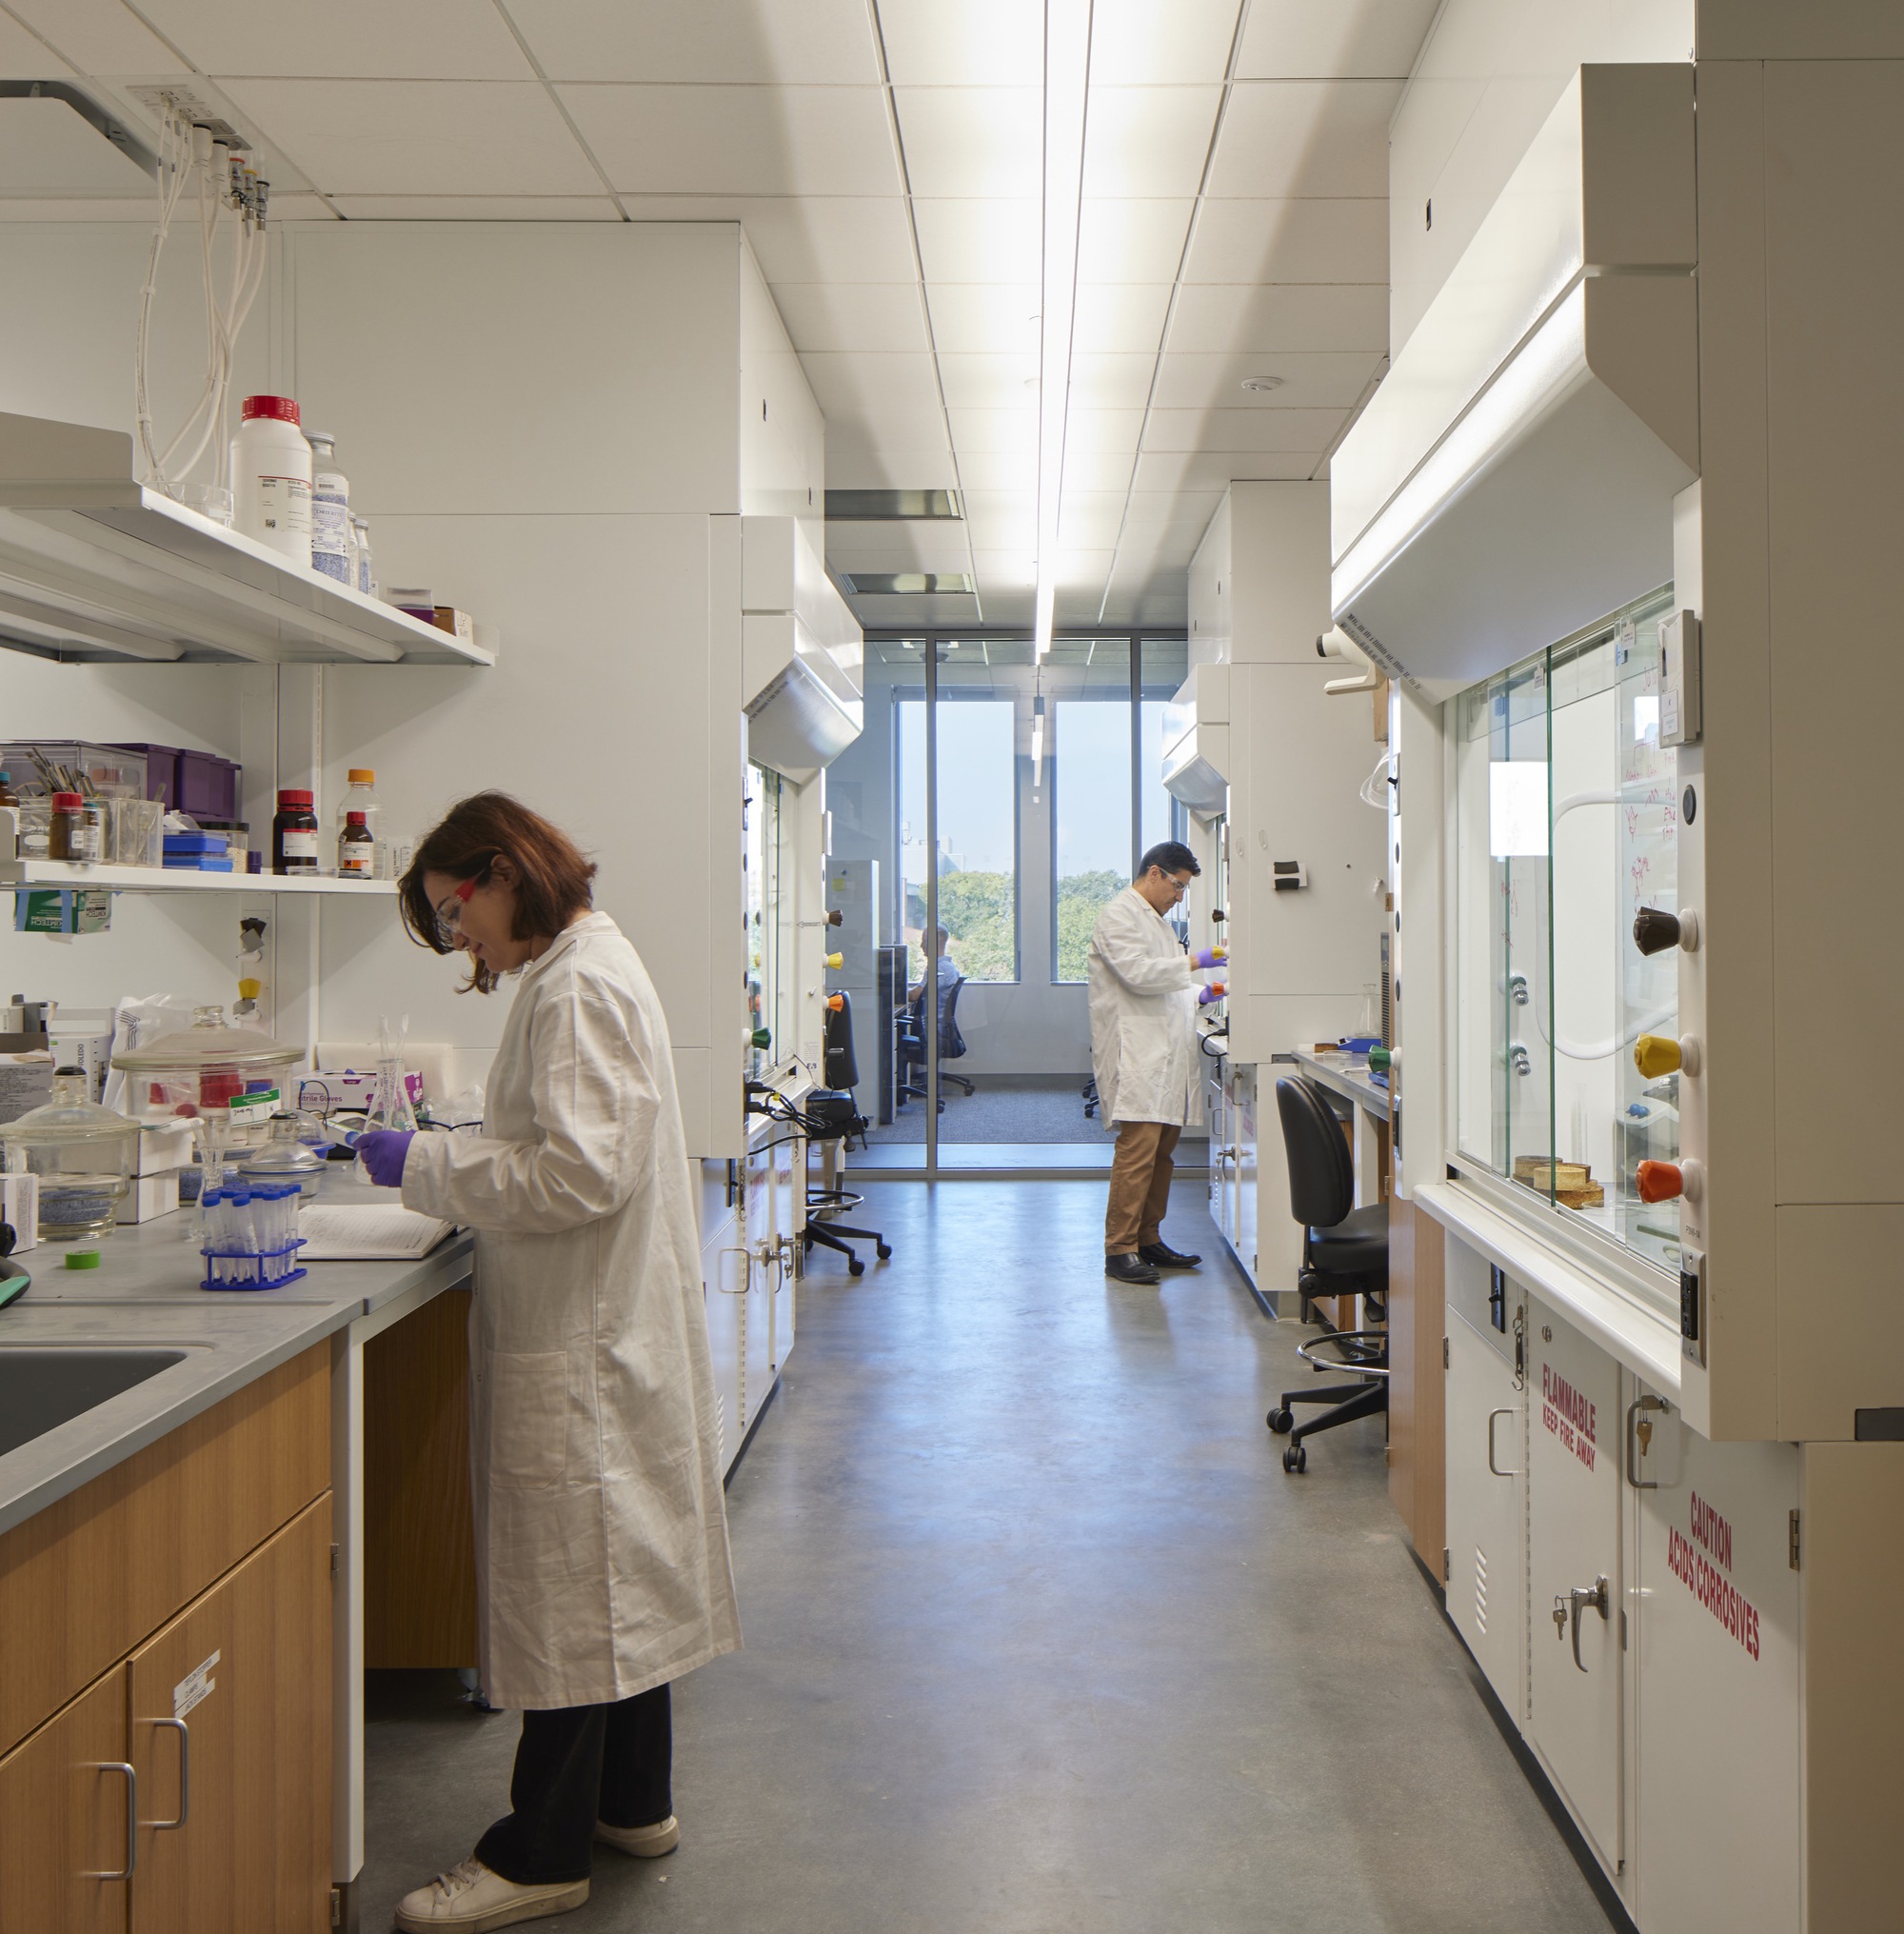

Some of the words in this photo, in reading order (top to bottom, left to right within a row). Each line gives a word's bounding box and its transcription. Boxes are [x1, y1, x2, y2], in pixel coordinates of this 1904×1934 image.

[1543, 1363, 1596, 1445] FLAMMABLE
[1543, 1403, 1557, 1435] KEEP
[1560, 1419, 1574, 1453] FIRE
[1577, 1436, 1596, 1472] AWAY
[1691, 1490, 1732, 1572] CAUTION
[1668, 1525, 1759, 1662] ACIDS/CORROSIVES
